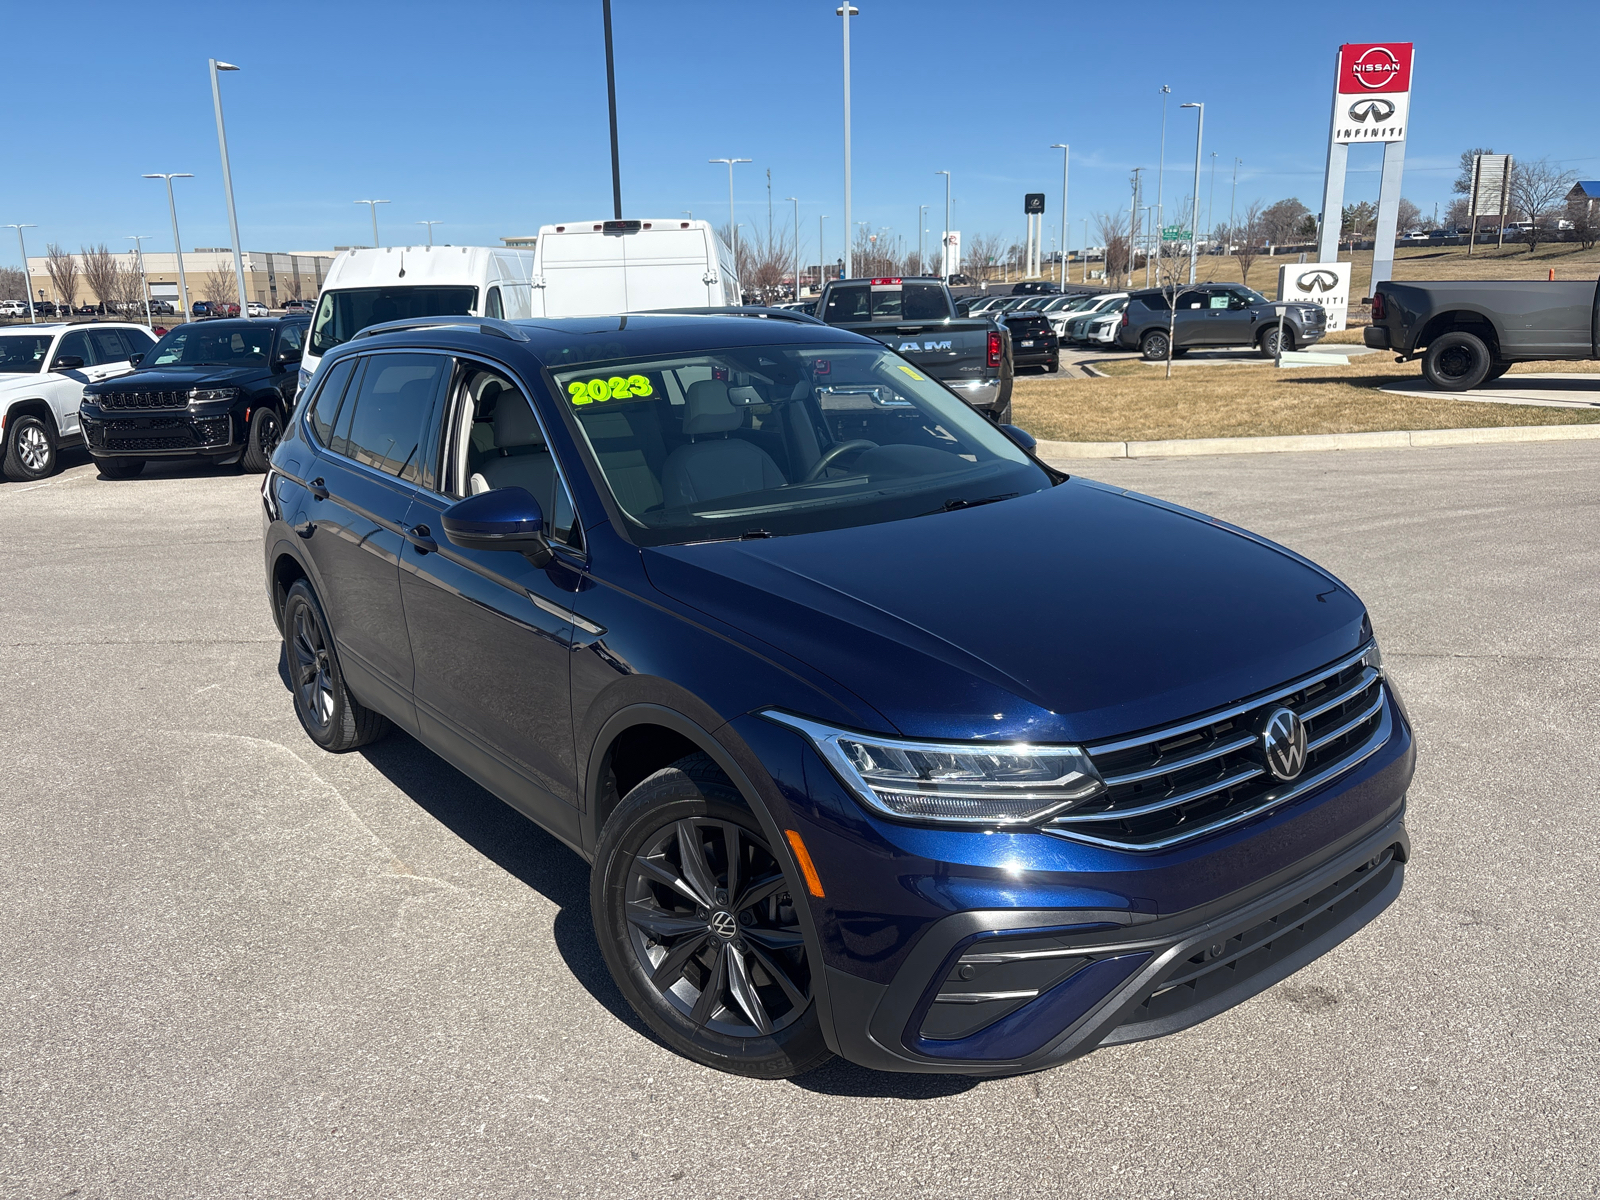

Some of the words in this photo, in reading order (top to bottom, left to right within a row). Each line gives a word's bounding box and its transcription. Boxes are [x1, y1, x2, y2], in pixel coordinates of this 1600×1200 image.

[1352, 64, 1400, 72] NISSAN
[1337, 127, 1402, 138] INFINITI
[884, 341, 952, 353] AM
[568, 375, 653, 406] 2023
